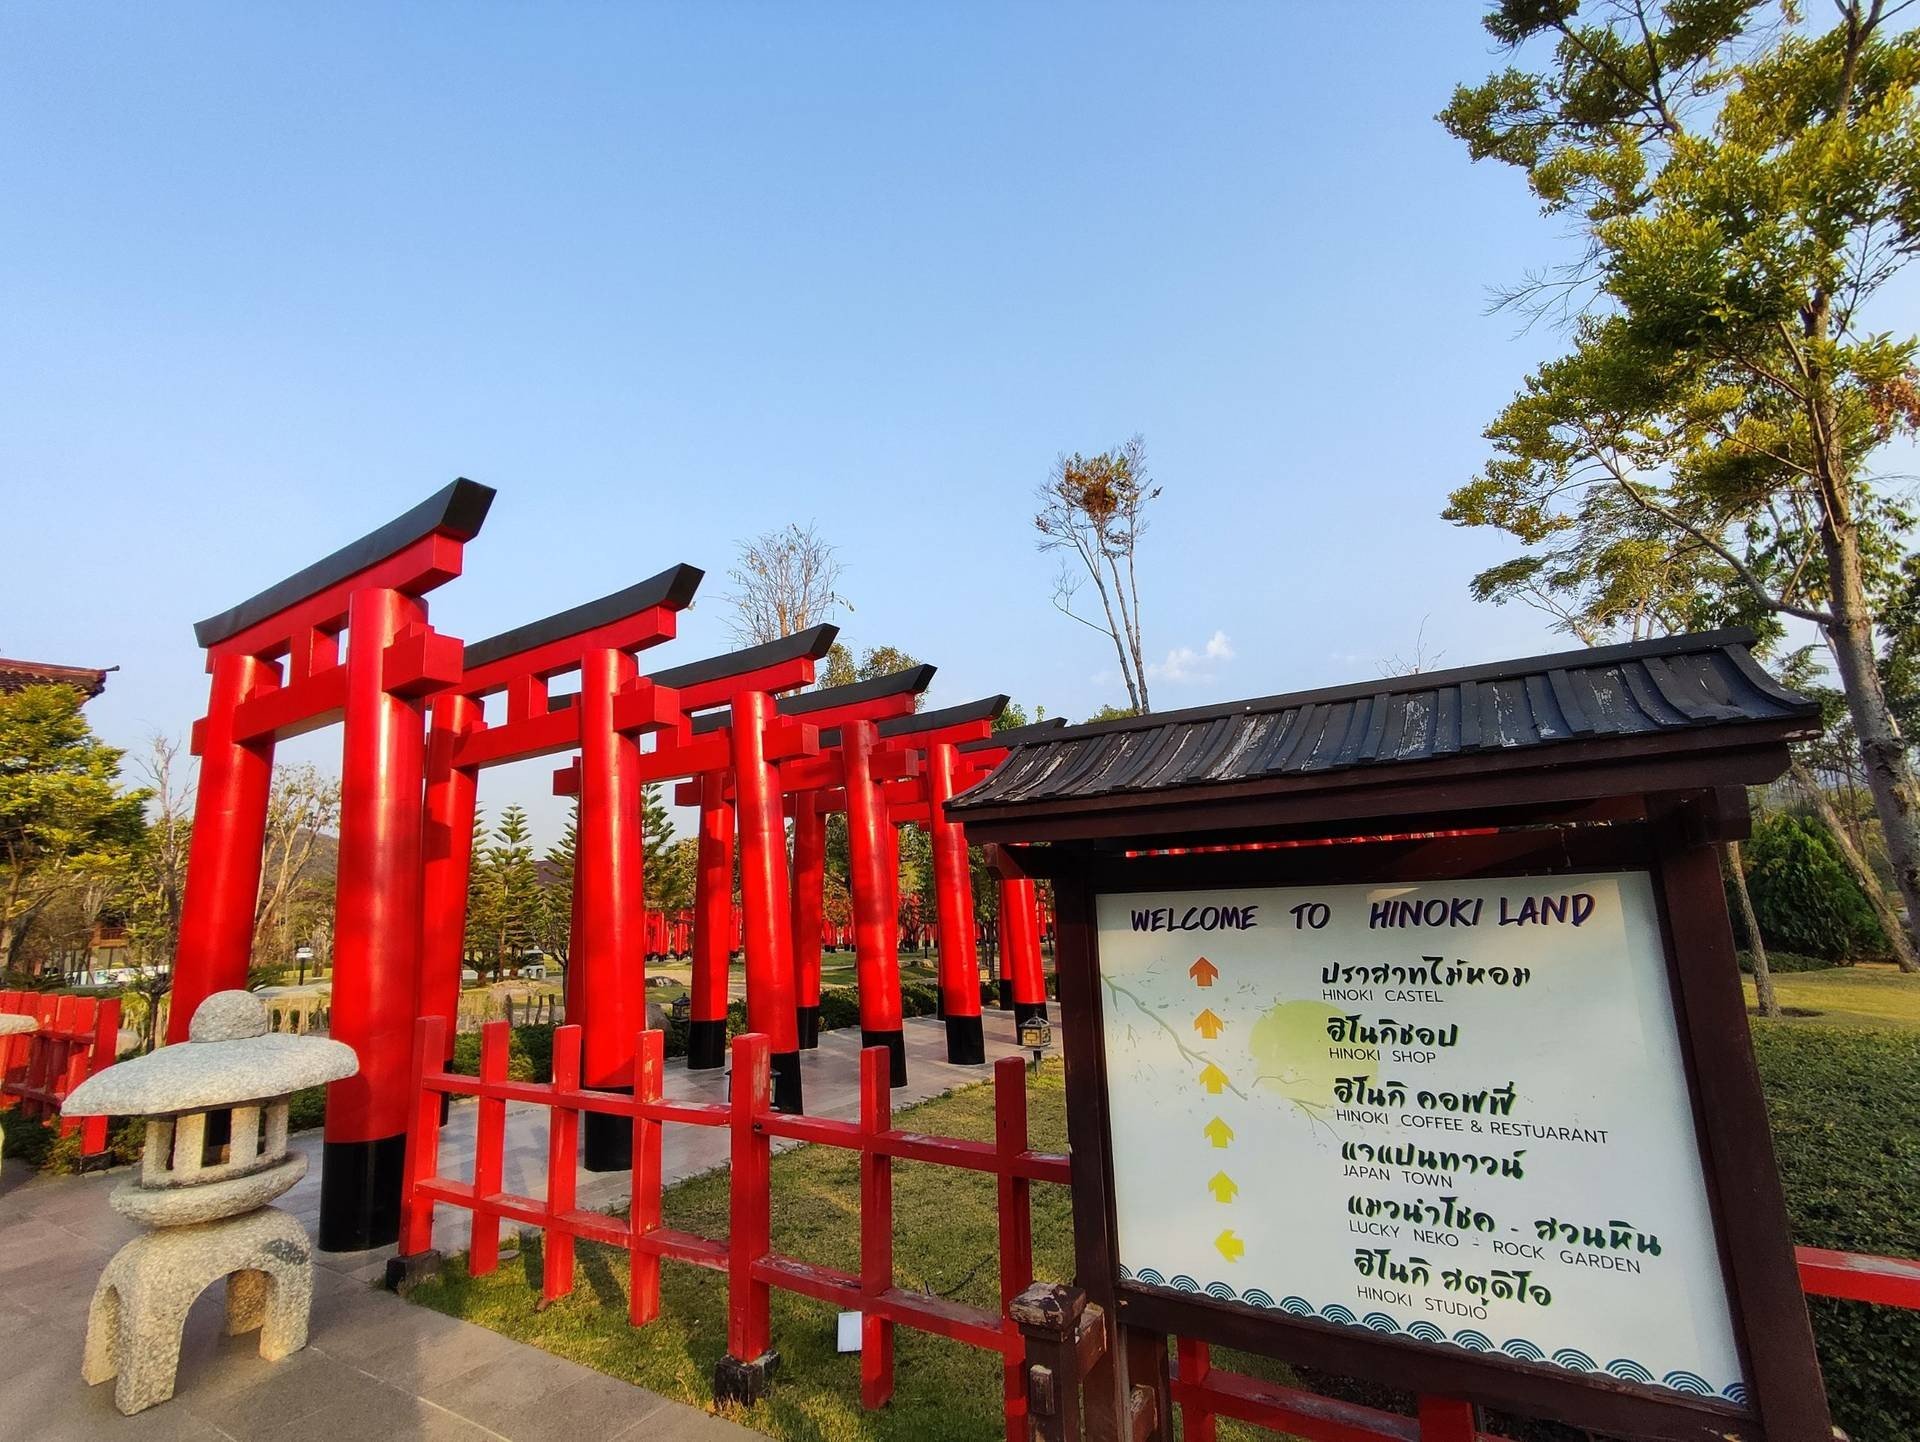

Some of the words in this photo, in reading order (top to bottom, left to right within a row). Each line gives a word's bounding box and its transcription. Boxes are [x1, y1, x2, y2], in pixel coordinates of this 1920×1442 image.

[1131, 905, 1258, 932] WELCOME
[1290, 903, 1331, 929] TO
[1370, 898, 1483, 929] HINOKI
[1498, 894, 1596, 927] LAND
[1322, 956, 1530, 986] ปราสาทไม้หอม
[1322, 989, 1373, 1001] HINOKI
[1385, 990, 1443, 1002] CASTEL
[1329, 1048, 1380, 1061] HINOKI
[1392, 1050, 1436, 1063] SHOP
[1334, 1075, 1408, 1108] ฮิโนกิ
[1417, 1081, 1516, 1116] คอฟฟี่
[1336, 1109, 1389, 1125] HINOKI
[1401, 1114, 1464, 1131] COFFEE
[1470, 1120, 1483, 1133] &
[1490, 1121, 1608, 1144] RESTUARANT
[1342, 1141, 1527, 1179] แจแปนทาวน์
[1343, 1165, 1390, 1181] JAPAN
[1402, 1171, 1453, 1188] TOWN
[1348, 1195, 1495, 1233] แมวนำโชค
[1535, 1217, 1662, 1256] สวนหิน
[1349, 1219, 1399, 1238] LUCKY
[1413, 1228, 1459, 1247] NEKO
[1493, 1241, 1546, 1260] ROCK
[1559, 1250, 1641, 1274] GARDEN
[1354, 1248, 1432, 1287] ฮิโนกิ
[1357, 1285, 1412, 1307] HINOKI
[1424, 1297, 1488, 1320] STUDIO
